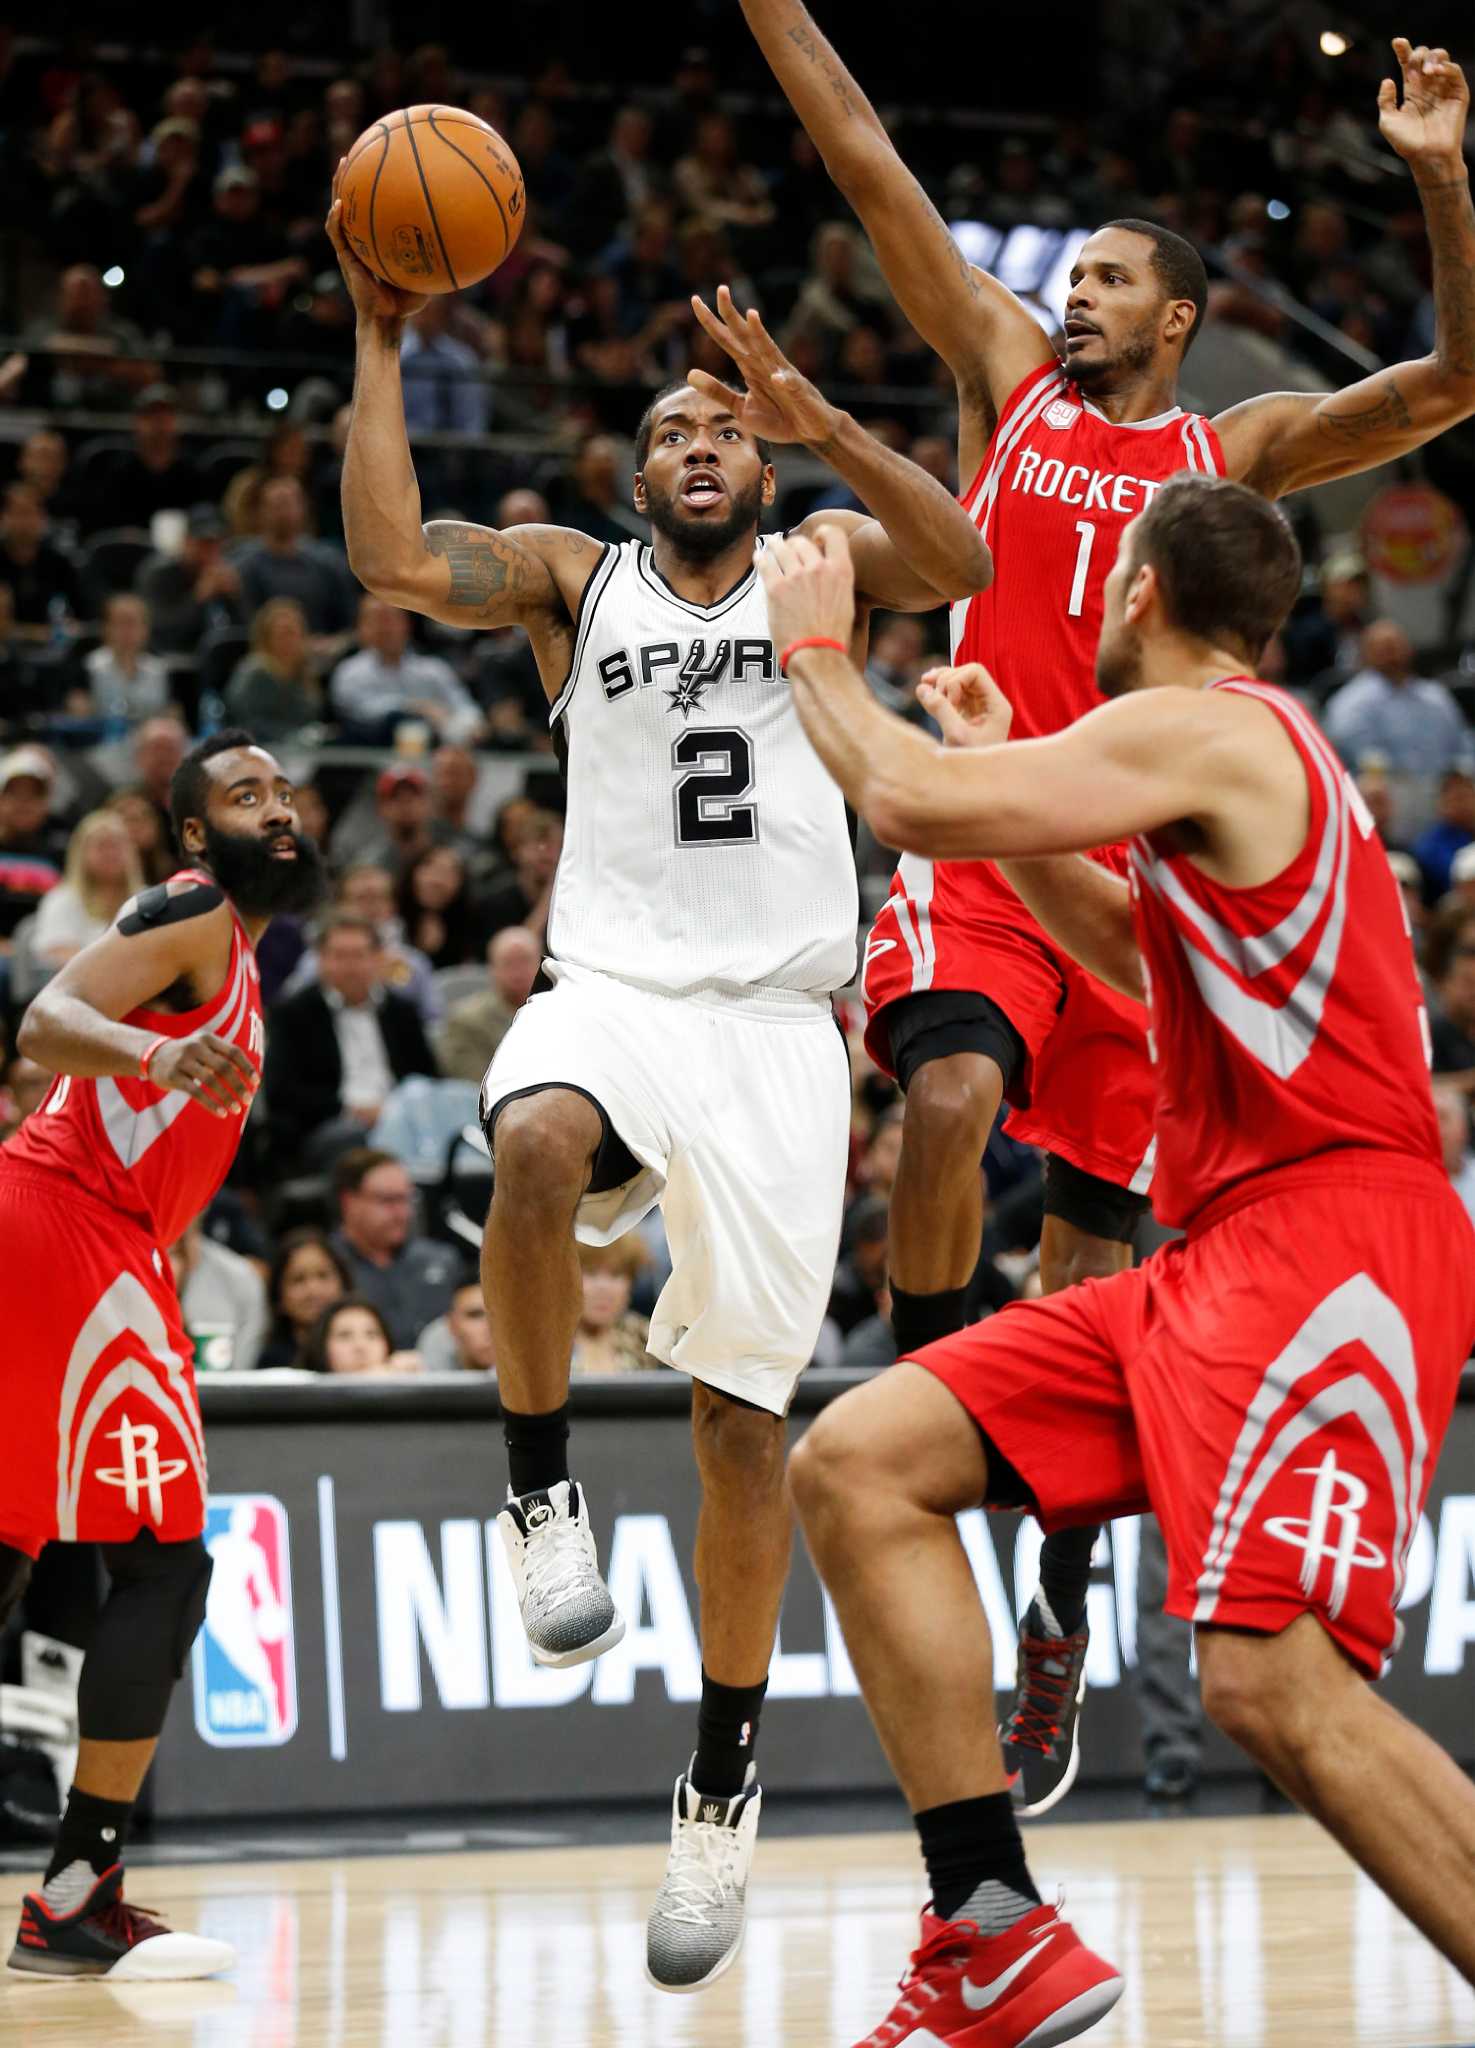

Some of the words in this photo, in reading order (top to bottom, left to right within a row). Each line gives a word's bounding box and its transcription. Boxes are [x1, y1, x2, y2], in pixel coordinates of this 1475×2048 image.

[1068, 520, 1096, 617] 1
[598, 639, 788, 703] SPUR
[671, 726, 760, 849] 2
